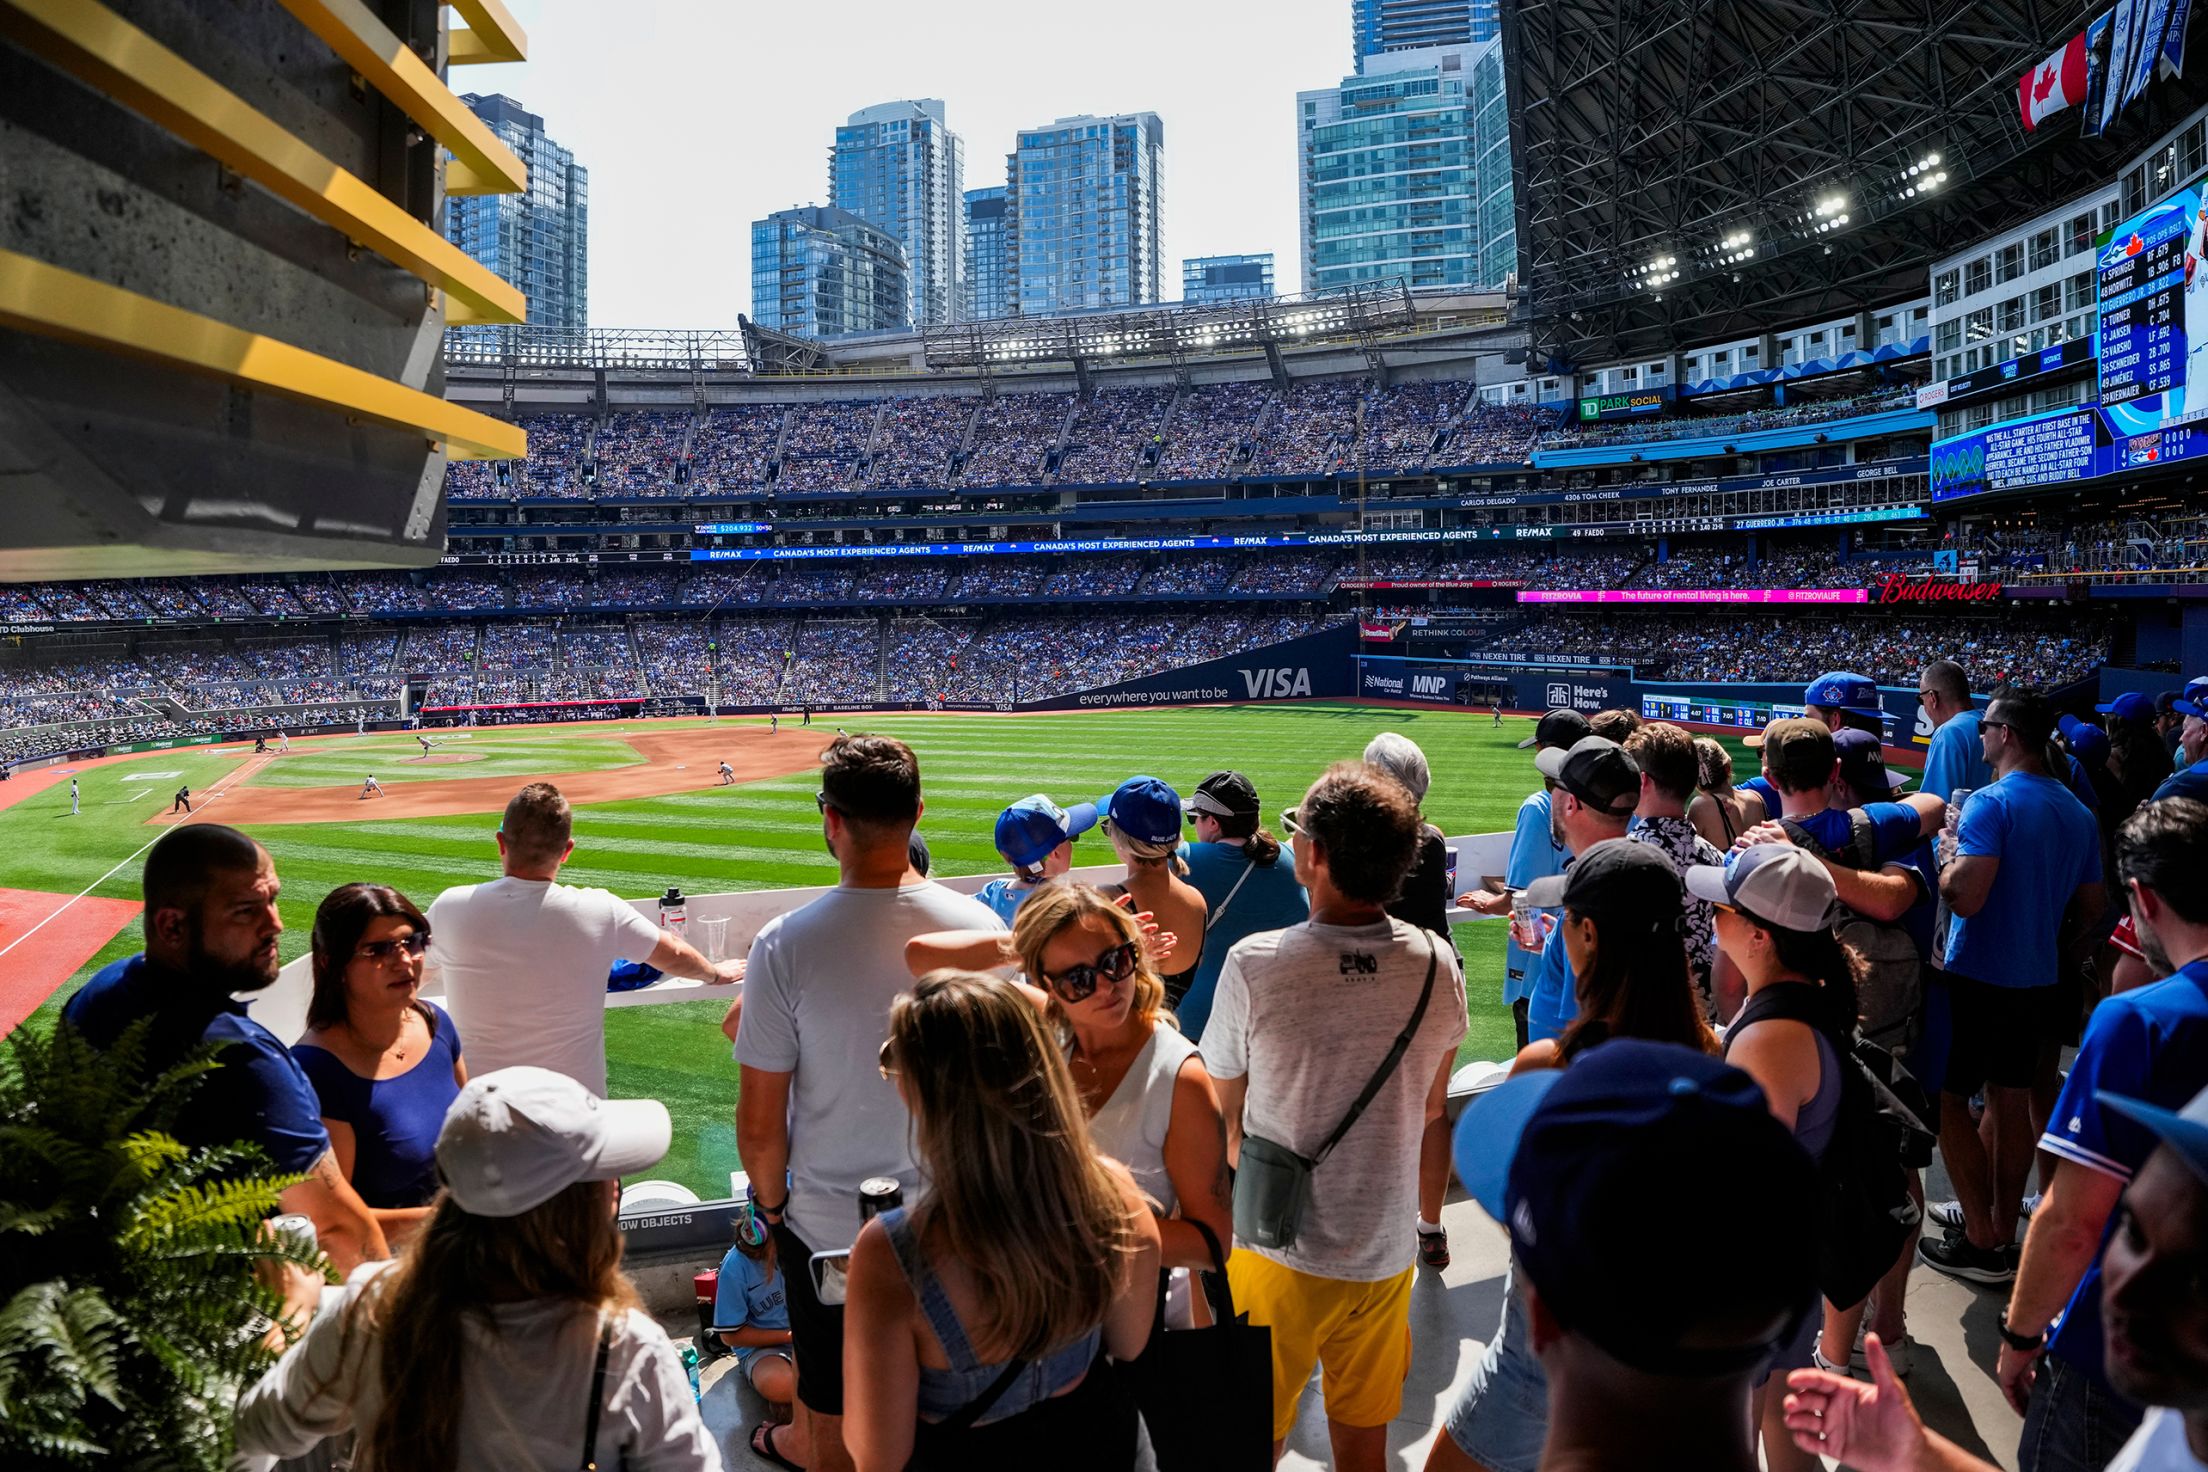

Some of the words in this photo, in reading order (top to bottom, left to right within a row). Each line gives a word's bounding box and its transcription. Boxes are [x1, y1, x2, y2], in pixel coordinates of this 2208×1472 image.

[2108, 260, 2135, 280] SPRINGER
[2147, 250, 2155, 262] RF
[2148, 267, 2155, 278] 1B
[2101, 302, 2109, 313] 27
[2109, 291, 2136, 309] GUERRERO
[2103, 318, 2107, 328] 2
[2109, 308, 2131, 326] TURNER
[2103, 333, 2107, 343] 9
[2109, 324, 2131, 341] JANSEN
[2150, 315, 2154, 326] C
[2158, 309, 2170, 323] .704
[2102, 347, 2109, 359] 25
[2109, 340, 2132, 357] VARSHO
[2149, 331, 2156, 343] LF
[2158, 326, 2170, 339] .692
[2102, 363, 2109, 374] 36
[2109, 353, 2140, 372] SCHNEIDER
[2149, 347, 2156, 359] 2B
[2158, 342, 2170, 356] .700
[2102, 378, 2109, 389] 49
[2110, 371, 2134, 388] JIMÉNEZ
[2149, 364, 2157, 375] SS
[2158, 359, 2170, 373] .865
[1925, 388, 1944, 401] ROGERS
[2102, 394, 2109, 405] 39
[2110, 385, 2140, 403] KIERMAIER
[2149, 380, 2156, 391] CF
[2159, 376, 2170, 389] .539
[1582, 403, 1598, 416] TD
[1601, 397, 1630, 410] PARK
[1631, 395, 1662, 407] SOCIAL
[1994, 433, 2003, 442] THE
[2004, 431, 2012, 440] A.L.
[2013, 426, 2035, 438] STARTER
[2035, 424, 2042, 433] AT
[2042, 421, 2056, 432] FIRST
[2058, 418, 2071, 429] BASE
[2072, 417, 2078, 426] IN
[2079, 414, 2090, 425] THE
[1991, 441, 2011, 452] ALL-STAR
[2027, 436, 2036, 445] HIS
[2037, 432, 2057, 443] FOURTH
[2058, 427, 2083, 439] ALL-STAR
[2024, 447, 2034, 456] AND
[2035, 445, 2044, 453] HIS
[2044, 440, 2064, 452] FATHER
[2065, 435, 2091, 448] VLADIMIR
[2008, 457, 2027, 468] BECAME
[2028, 455, 2037, 465] THE
[2038, 451, 2059, 463] SECOND
[2059, 445, 2093, 459] FATHER-SON
[1857, 468, 1882, 478] GEORGE
[1884, 466, 1898, 475] BELL
[1995, 471, 2001, 479] TO
[2002, 468, 2015, 478] EACH
[2015, 467, 2022, 476] BE
[2022, 465, 2040, 475] NAMED
[2040, 463, 2048, 472] AN
[2048, 460, 2073, 471] ALL-STAR
[2074, 457, 2089, 467] FOUR
[1762, 479, 1775, 487] JOE
[1777, 477, 1801, 486] CARTER
[2007, 477, 2026, 487] JOINING
[2027, 475, 2037, 484] GUS
[2038, 473, 2048, 482] AND
[2049, 470, 2067, 481] BUDDY
[2068, 468, 2081, 478] BELL
[1599, 491, 1620, 500] CHEEK
[1682, 485, 1719, 494] FERNANDEZ
[1736, 521, 1744, 529] 27
[1746, 519, 1776, 528] GUERRERO
[1308, 534, 1352, 544] CANADA'S
[1354, 533, 1378, 542] MOST
[1380, 532, 1441, 541] EXPERIENCED
[1443, 531, 1478, 540] AGENTS
[1516, 528, 1552, 537] RE/MAX
[1584, 529, 1605, 537] FAEDO
[1034, 542, 1076, 551] CANADA'S
[1078, 541, 1101, 550] MOST
[1103, 540, 1160, 550] EXPERIENCED
[1162, 539, 1195, 548] AGENTS
[1234, 537, 1267, 546] RE/MAX
[710, 550, 742, 559] RE/MAX
[774, 549, 815, 558] CANADA'S
[817, 549, 839, 557] MOST
[841, 547, 896, 556] EXPERIENCED
[899, 546, 931, 555] AGENTS
[963, 544, 995, 553] RE/MAX
[1877, 572, 2001, 604] Budweiser
[1638, 592, 1662, 600] future
[1663, 592, 1672, 600] of
[1674, 592, 1699, 600] rental
[1700, 591, 1722, 602] living
[1723, 592, 1730, 600] is
[1730, 591, 1750, 600] here.
[10, 625, 55, 633] Clubhouse
[1451, 629, 1487, 637] COLOUR
[1483, 653, 1508, 661] NEXEN
[1547, 655, 1571, 663] NEXEN
[1573, 656, 1591, 664] TIRE
[1237, 668, 1312, 698] VISA
[1375, 676, 1404, 689] National
[1412, 675, 1446, 694] MNP
[1080, 693, 1148, 706] everywhere
[1149, 690, 1170, 703] you
[1172, 689, 1198, 701] want
[1201, 688, 1212, 699] to
[1214, 686, 1228, 699] be
[1574, 686, 1608, 698] Here's
[995, 703, 1013, 712] VISA
[1574, 697, 1602, 710] How.
[1756, 715, 1767, 723] 7:10
[1166, 834, 1177, 842] JAYS
[619, 1219, 638, 1232] OW
[642, 1215, 693, 1229] OBJECTS
